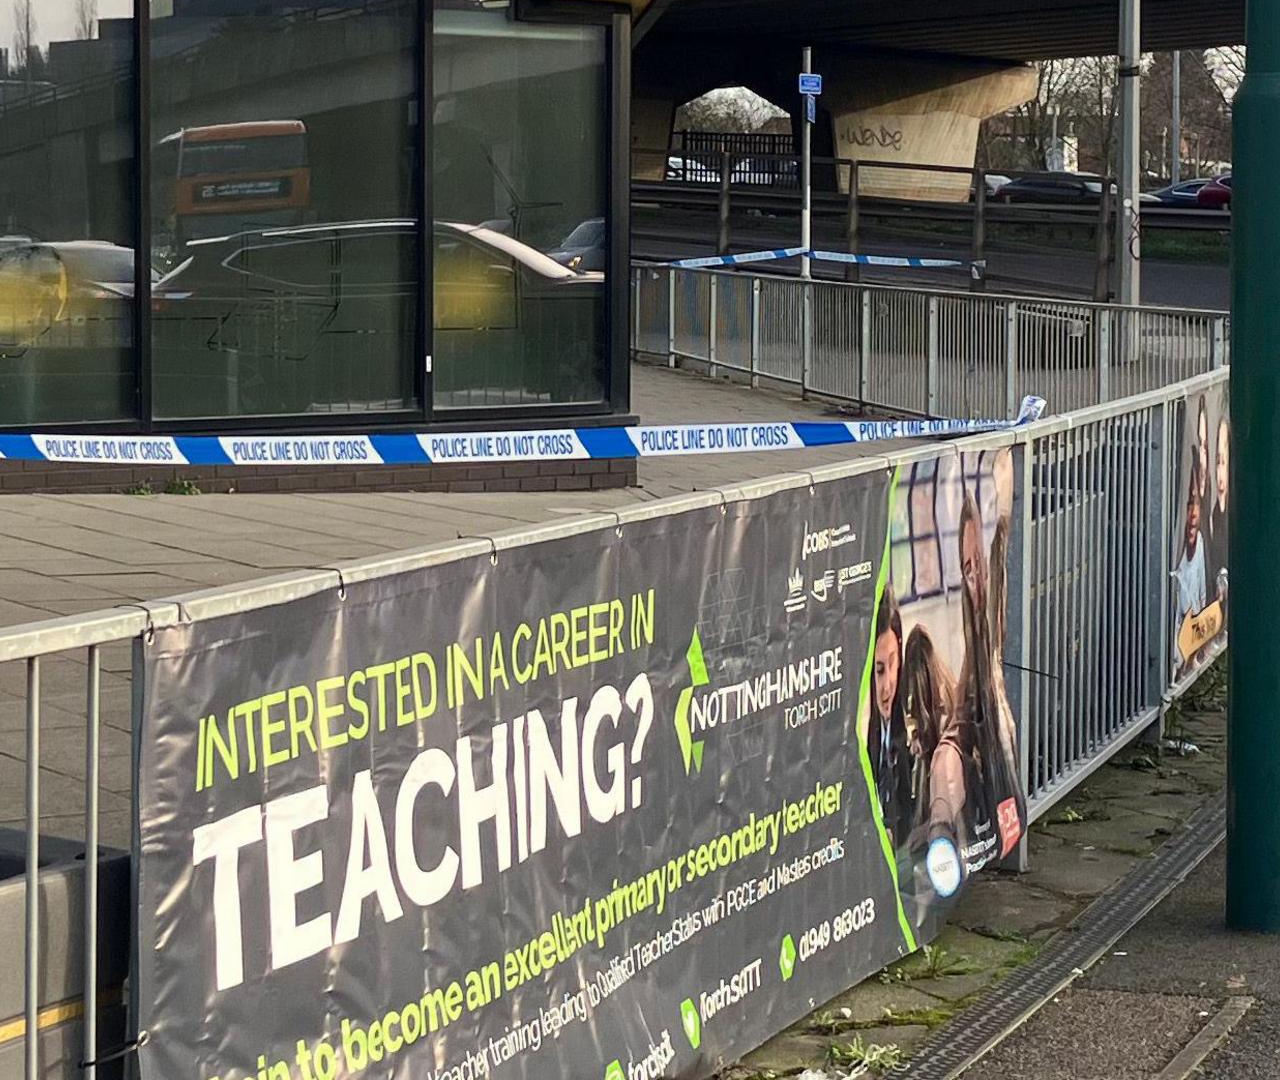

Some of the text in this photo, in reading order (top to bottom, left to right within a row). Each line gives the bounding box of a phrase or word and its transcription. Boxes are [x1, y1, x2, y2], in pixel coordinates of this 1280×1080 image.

[432, 434, 573, 458] POLICE LINE DO NOT CROSS
[641, 425, 788, 451] POLICE LINE DO NOT CROSS
[859, 422, 897, 441] POLICE
[46, 438, 173, 460] POLICE LINE DO NOT CROSS
[233, 440, 367, 461] POLICE LINE DO NOT CROSS
[196, 590, 655, 791] INTERESTED IN A CAREER IN
[193, 672, 655, 991] TEACHING?
[296, 1039, 336, 1080] to
[341, 981, 464, 1074] become
[465, 961, 501, 1011] an
[504, 897, 596, 990] excellent
[595, 878, 666, 948] primary
[667, 854, 686, 893] or
[686, 813, 781, 882] secondary
[783, 781, 842, 836] teacher
[799, 920, 830, 961] 01949
[489, 1019, 541, 1067] training
[539, 992, 587, 1037] leading
[586, 980, 601, 1008] to
[596, 948, 635, 998] Qualified
[634, 931, 673, 970] Teacher
[672, 911, 702, 946] Status
[701, 895, 725, 928] with
[727, 878, 756, 916] PGCE
[757, 868, 775, 901] and
